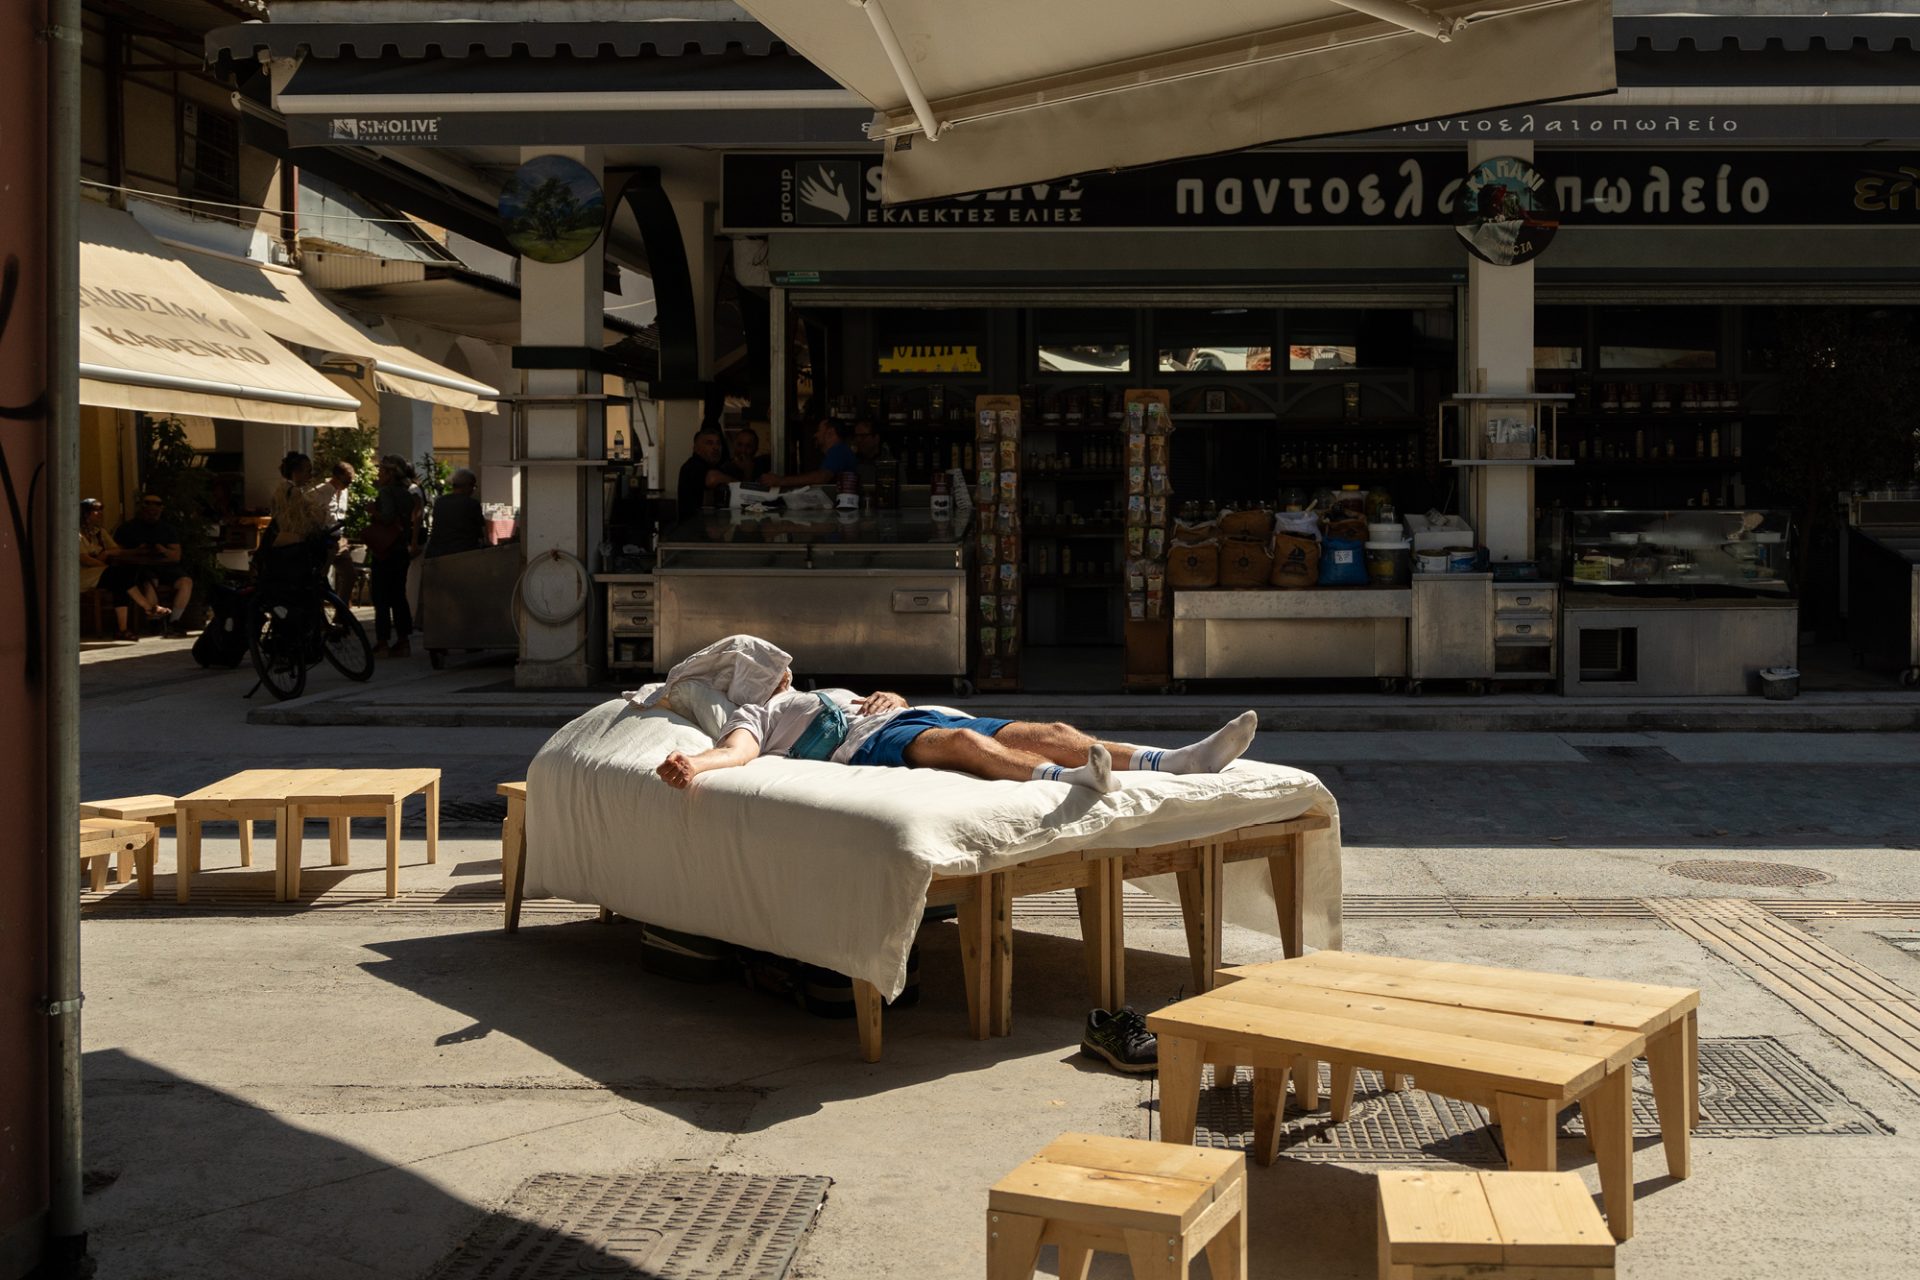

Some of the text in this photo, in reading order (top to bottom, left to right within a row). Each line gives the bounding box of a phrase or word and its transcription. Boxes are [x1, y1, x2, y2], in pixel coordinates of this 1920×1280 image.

[780, 168, 794, 223] group
[866, 208, 1083, 223] ΕΚΛΕΚΤΕΣ ΕΛΙΕΣ
